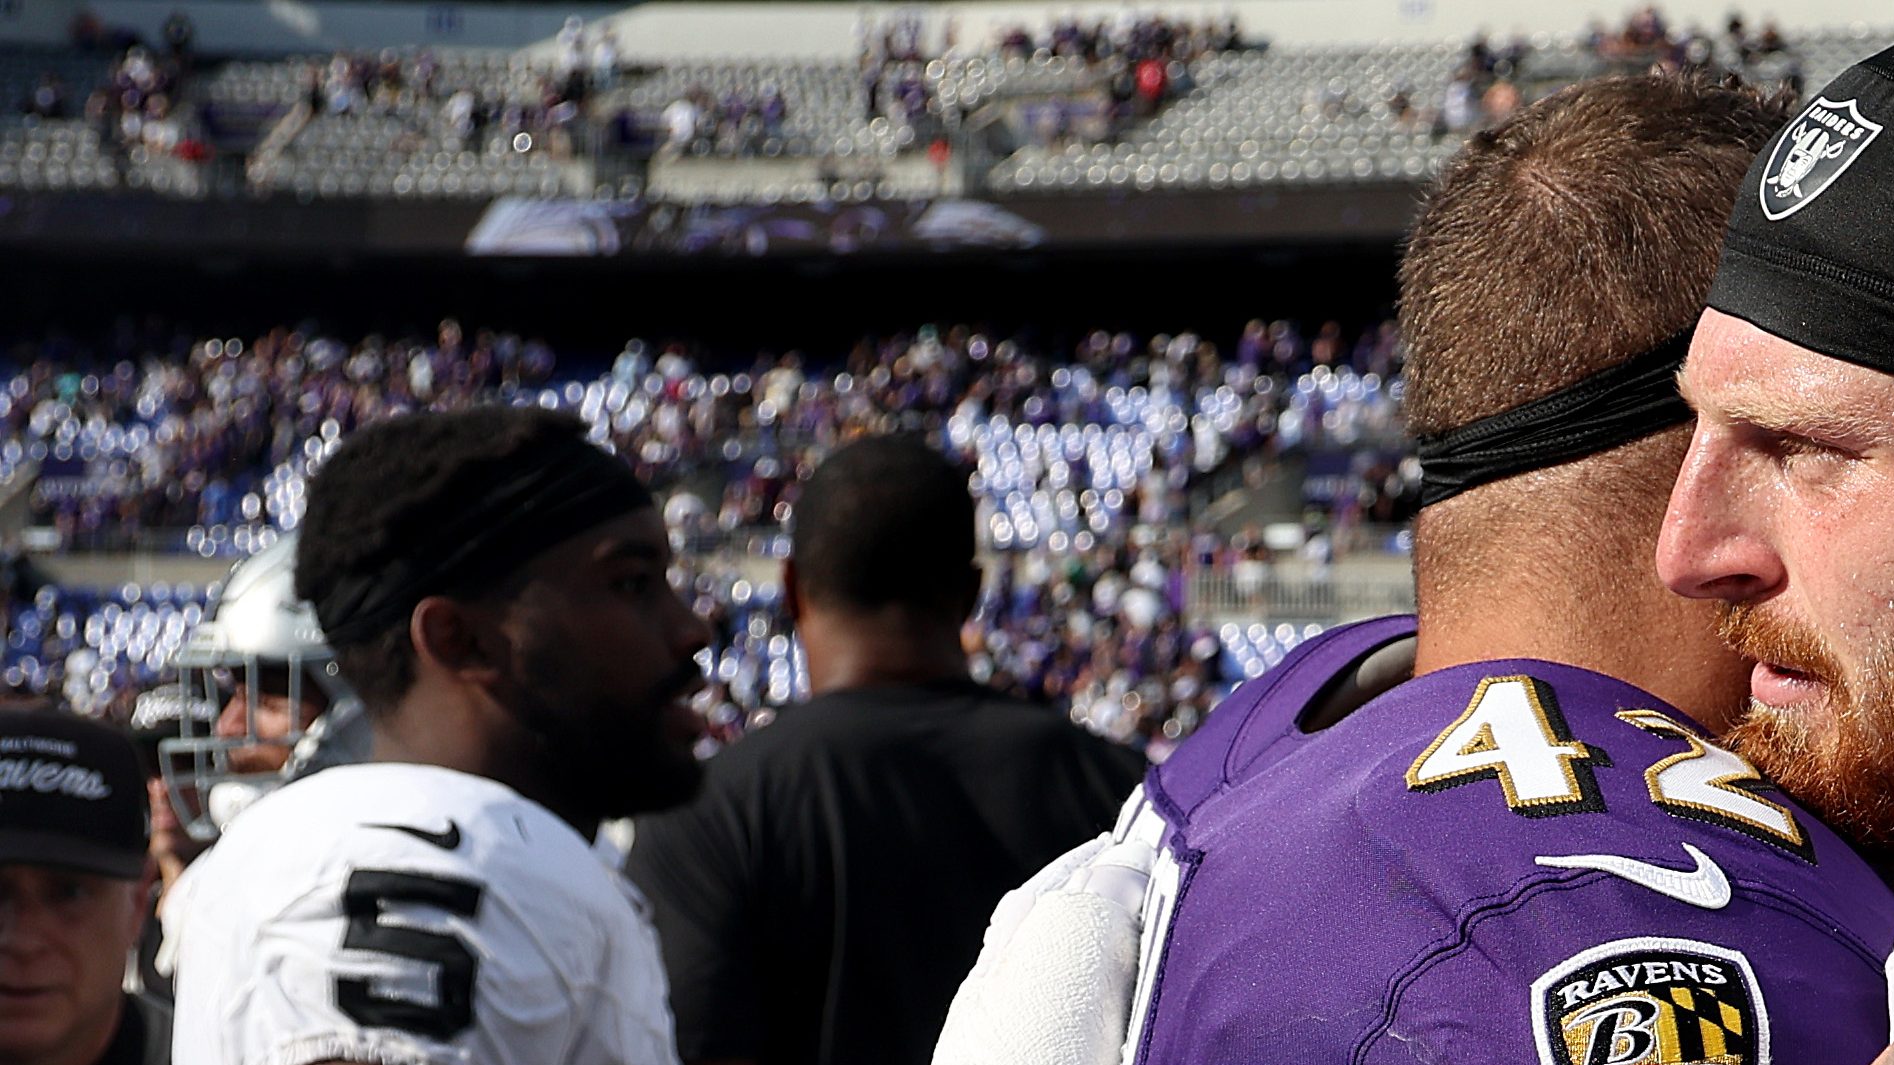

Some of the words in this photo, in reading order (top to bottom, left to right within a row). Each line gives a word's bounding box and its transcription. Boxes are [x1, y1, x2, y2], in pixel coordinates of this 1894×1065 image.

[1808, 106, 1865, 140] RAIDERS
[0, 757, 112, 801] avens
[1404, 674, 1819, 867] 42
[333, 867, 486, 1042] 5
[1557, 960, 1728, 1010] RAVENS
